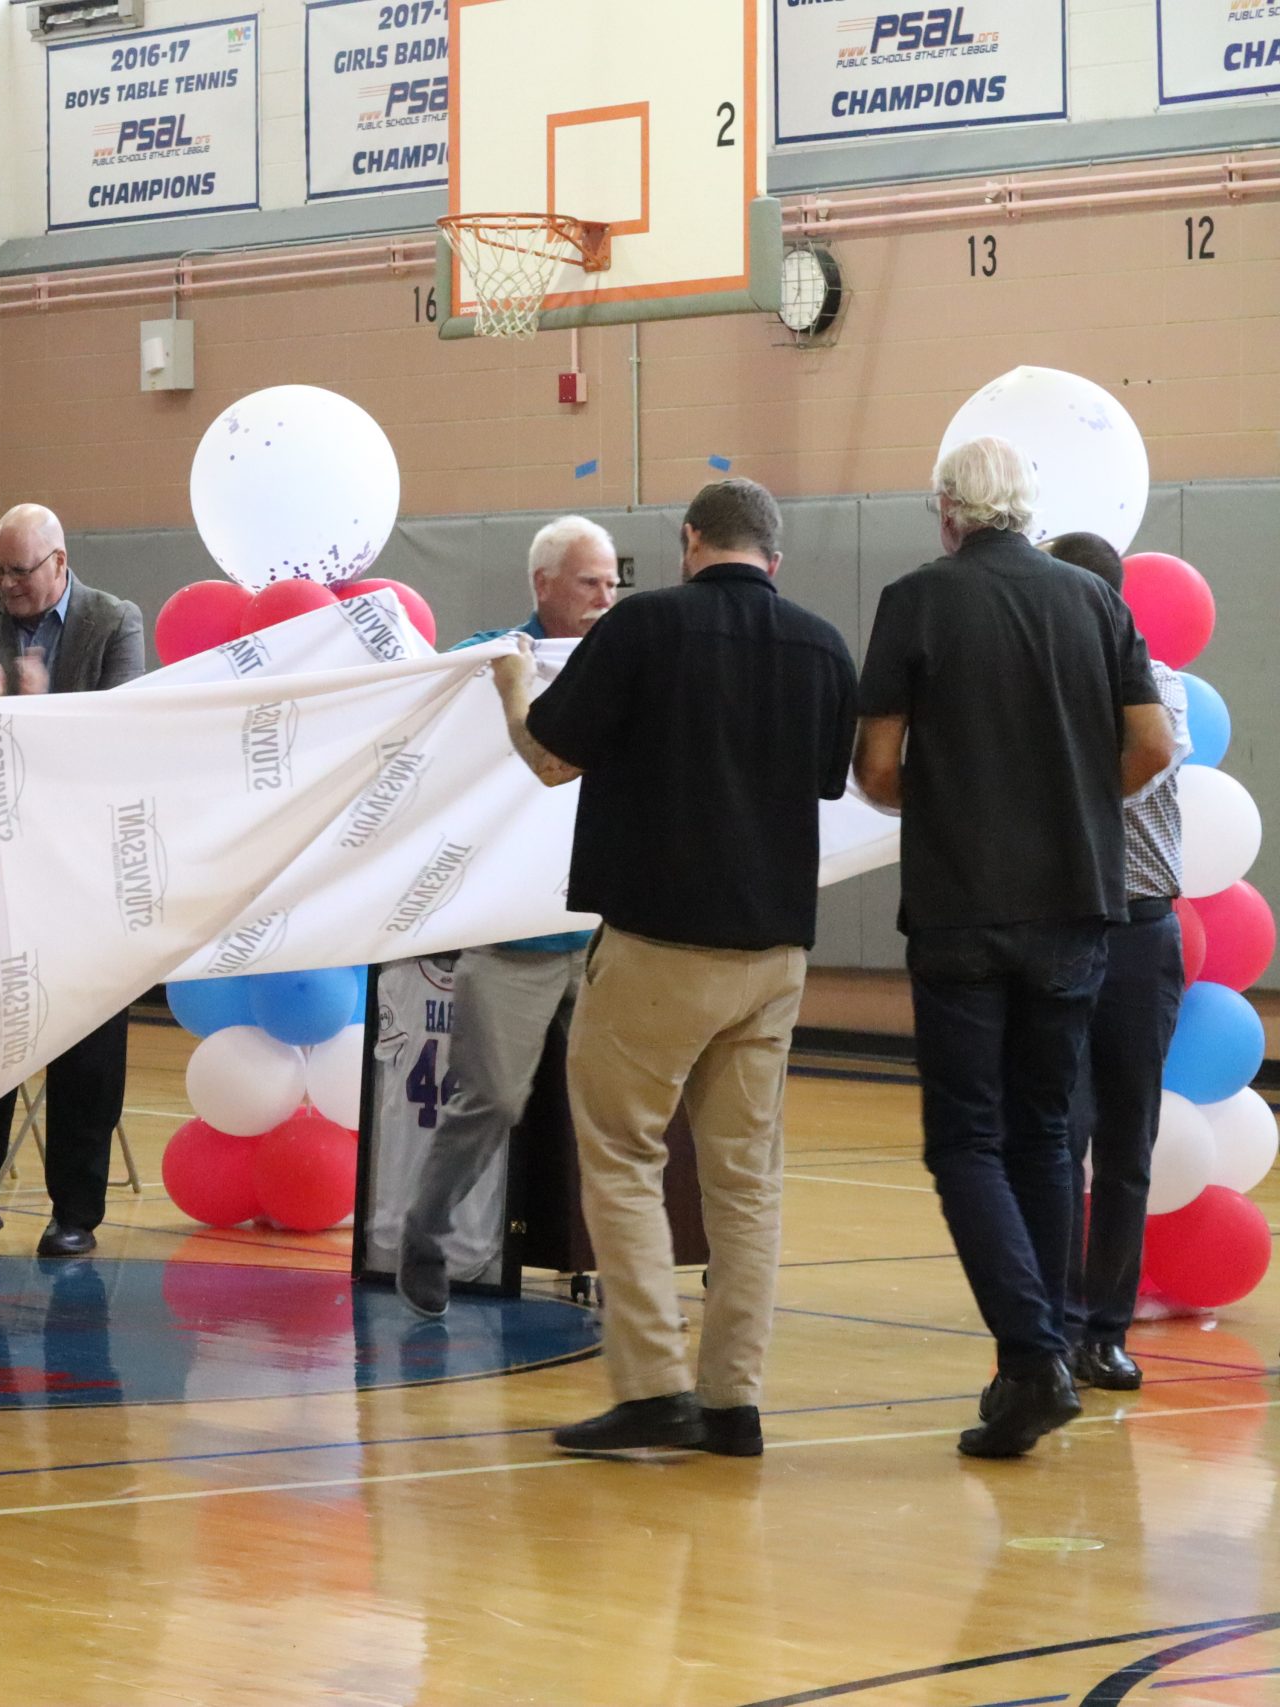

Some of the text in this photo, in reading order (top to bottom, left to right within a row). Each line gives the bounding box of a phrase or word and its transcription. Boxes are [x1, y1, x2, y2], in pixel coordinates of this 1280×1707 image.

[1228, 9, 1265, 22] PUBLIC
[110, 39, 190, 72] 2016-17
[334, 44, 389, 74] GIRLS
[836, 57, 868, 68] PUBLIC
[871, 52, 912, 65] SCHOOLS
[65, 68, 238, 110] BOYS TABLE TENNIS
[831, 75, 1008, 118] CHAMPIONS
[716, 102, 735, 147] 2
[352, 142, 448, 175] CHAMPI
[88, 172, 216, 208] CHAMPIONS
[968, 234, 998, 278] 13
[1185, 216, 1216, 260] 12
[414, 286, 436, 322] 16
